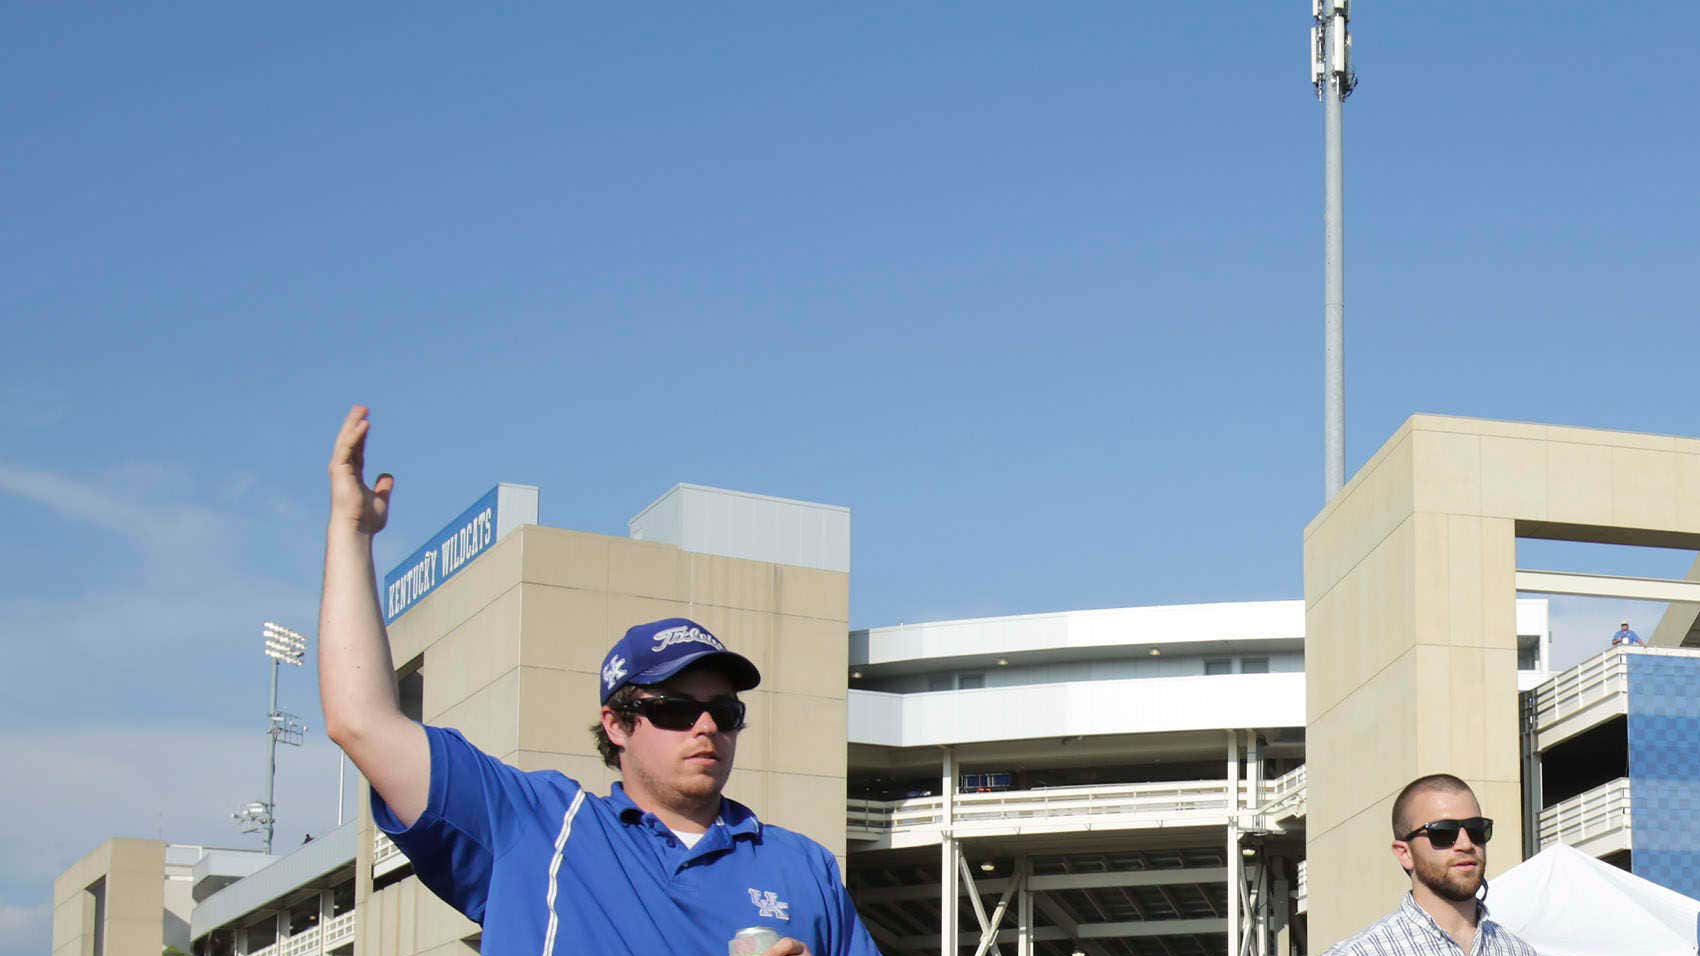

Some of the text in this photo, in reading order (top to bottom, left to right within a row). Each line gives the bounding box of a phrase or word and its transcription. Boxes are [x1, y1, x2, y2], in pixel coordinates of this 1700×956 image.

[388, 507, 492, 618] KENTUCKY WILDCATS
[748, 887, 790, 920] UK
